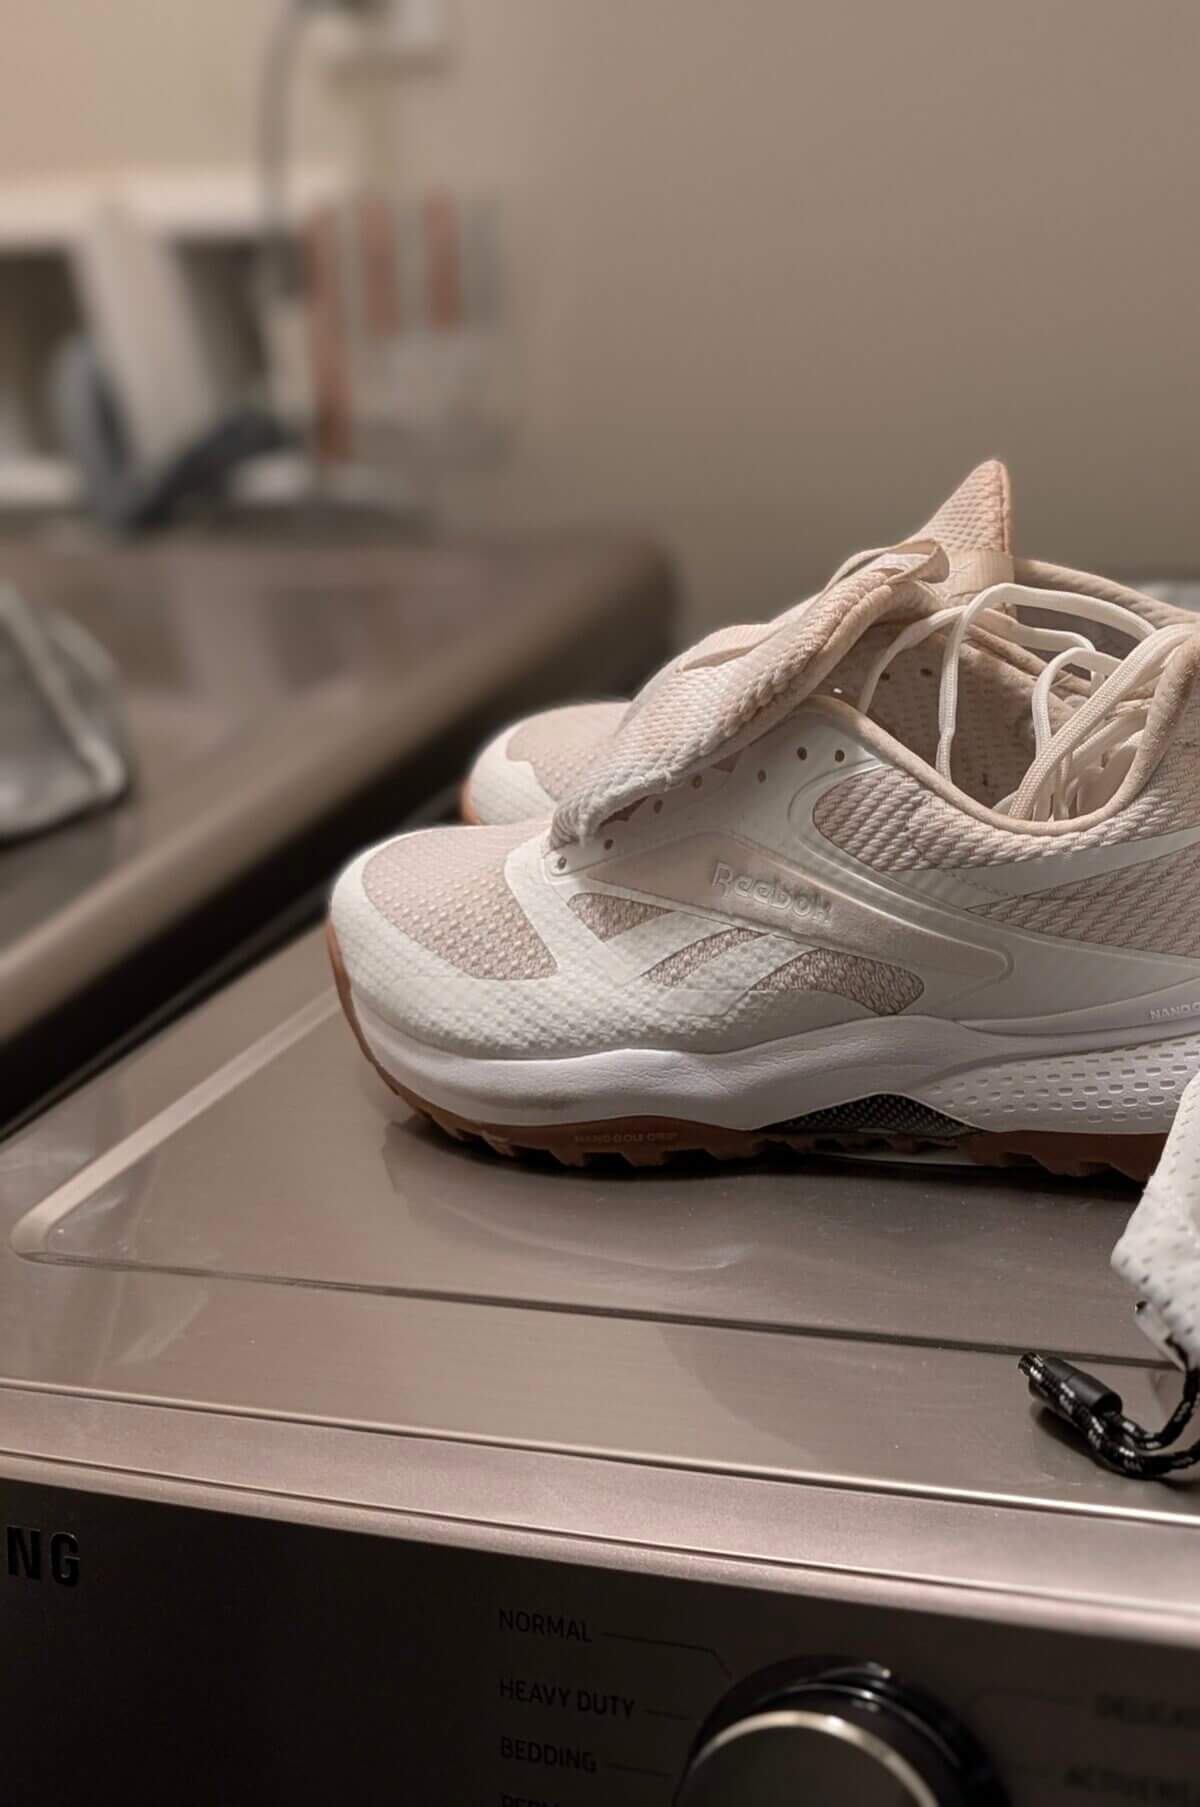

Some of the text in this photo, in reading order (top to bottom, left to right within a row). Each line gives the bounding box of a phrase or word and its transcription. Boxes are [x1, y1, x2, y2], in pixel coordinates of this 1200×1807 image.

[712, 861, 834, 926] Reebok
[4, 1524, 81, 1588] NG
[498, 1609, 592, 1642] NORMAL
[499, 1677, 635, 1719] HEAVY DUTY
[501, 1737, 597, 1774] BEDDING
